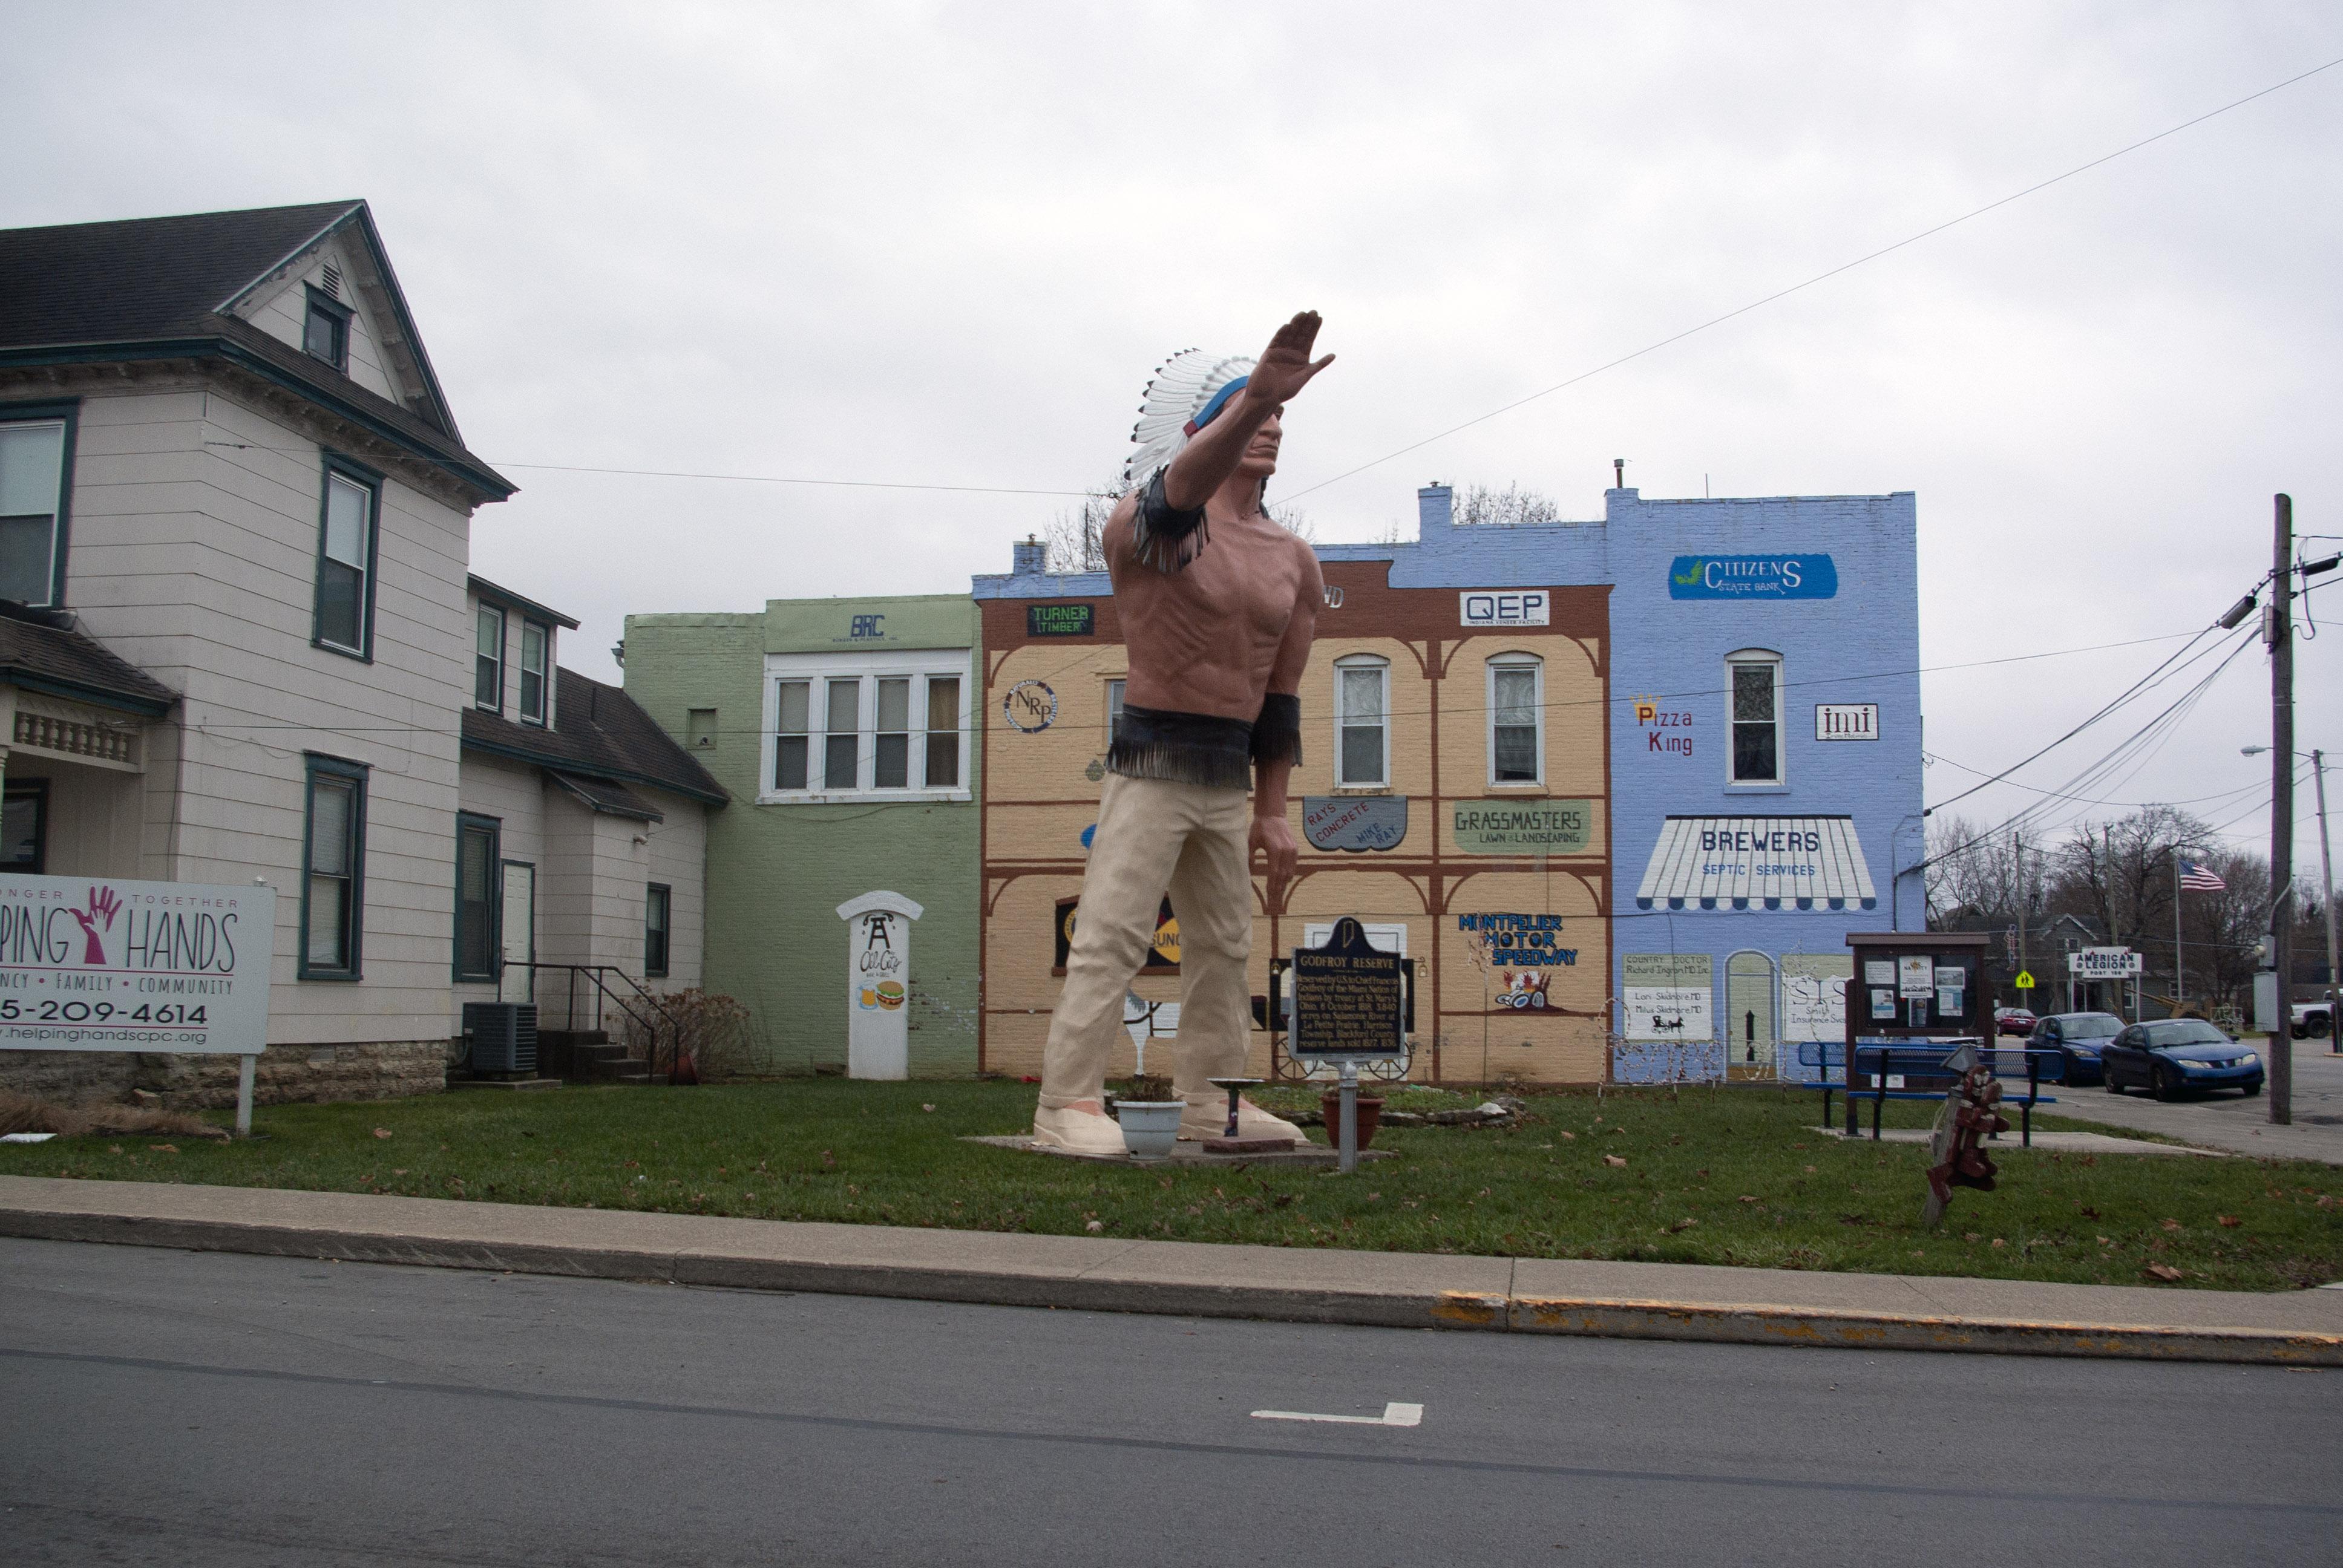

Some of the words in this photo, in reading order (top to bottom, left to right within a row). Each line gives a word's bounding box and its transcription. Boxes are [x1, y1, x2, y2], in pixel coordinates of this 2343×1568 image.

[1705, 561, 1801, 589] CITIZENS
[1719, 583, 1751, 595] STATE
[1754, 583, 1786, 596] BANK
[1034, 607, 1089, 621] TURNER
[1467, 595, 1542, 621] QEP
[850, 615, 885, 638] BRC
[1041, 621, 1080, 632] TIMBER
[1639, 707, 1692, 727] Pizza
[1824, 707, 1870, 733] imi
[1649, 731, 1693, 756] King
[1307, 803, 1336, 826] RAY'S
[1316, 802, 1369, 842] CONCRETE
[1455, 812, 1581, 830] GRASSMASTERS
[1356, 822, 1382, 843] MIKE
[1375, 825, 1397, 844] RAY
[1480, 832, 1506, 843] LAWN
[1515, 832, 1580, 843] LANDSCAPING
[1703, 864, 1746, 875] SEPTIC
[1756, 864, 1815, 876] SERVICES
[132, 895, 237, 908] TOGETHER
[1459, 913, 1564, 931] MONTPELIER
[0, 904, 69, 963] PING
[126, 909, 238, 973] HANDS
[1483, 932, 1557, 948] MOTOR
[1301, 955, 1347, 967] GODFROY
[1353, 958, 1395, 969] RESERVE
[1492, 949, 1578, 965] SPEEDWAY
[1627, 965, 1654, 974] Richard
[0, 973, 28, 988] NCY
[57, 973, 113, 991] FAMILY
[139, 978, 233, 995] COMMUNITY
[1792, 980, 1846, 1005] SIS
[1, 999, 208, 1024] 5-209-4614
[0, 1027, 206, 1045] .helpinghandscpc.org
